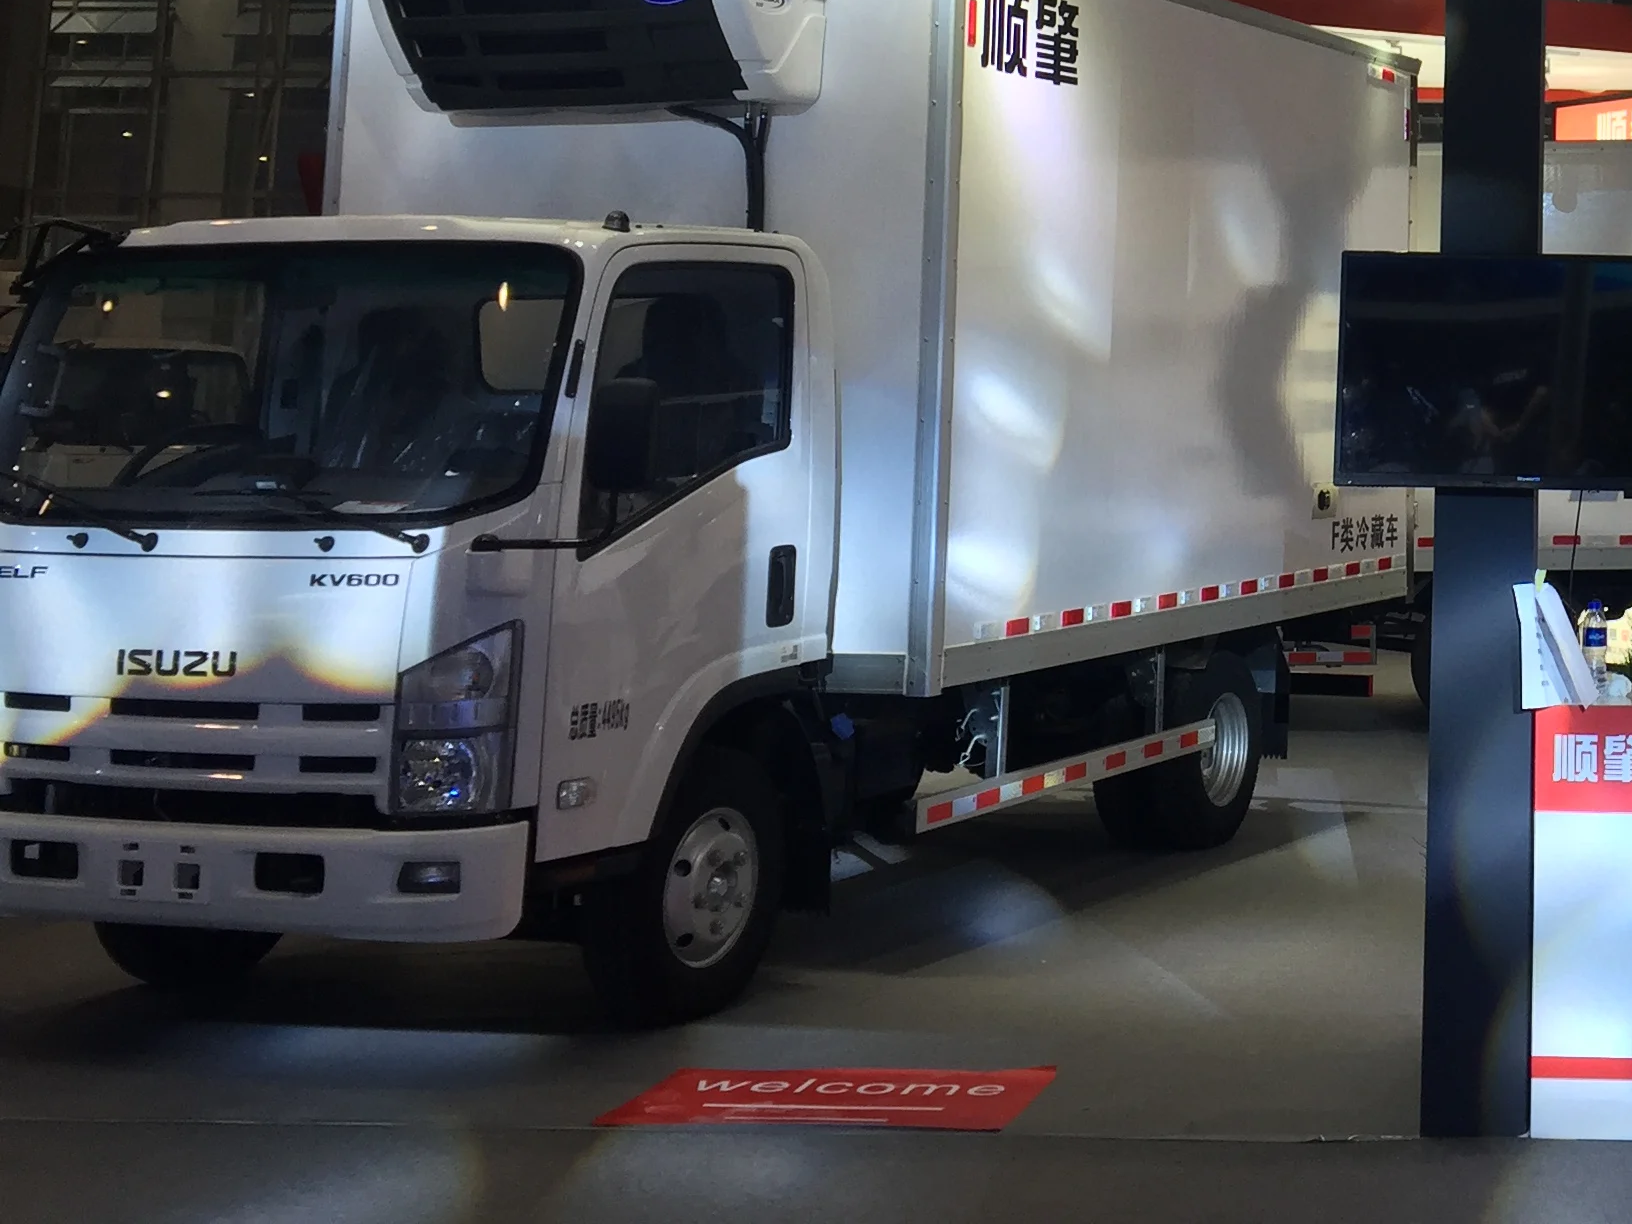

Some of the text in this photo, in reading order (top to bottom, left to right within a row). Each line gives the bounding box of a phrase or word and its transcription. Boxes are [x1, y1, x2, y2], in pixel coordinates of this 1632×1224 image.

[1331, 513, 1399, 554] F类冷藏车
[0, 566, 49, 579] ELF
[309, 573, 400, 587] KV600
[116, 649, 238, 677] ISUZU
[697, 1078, 1006, 1097] welcome
